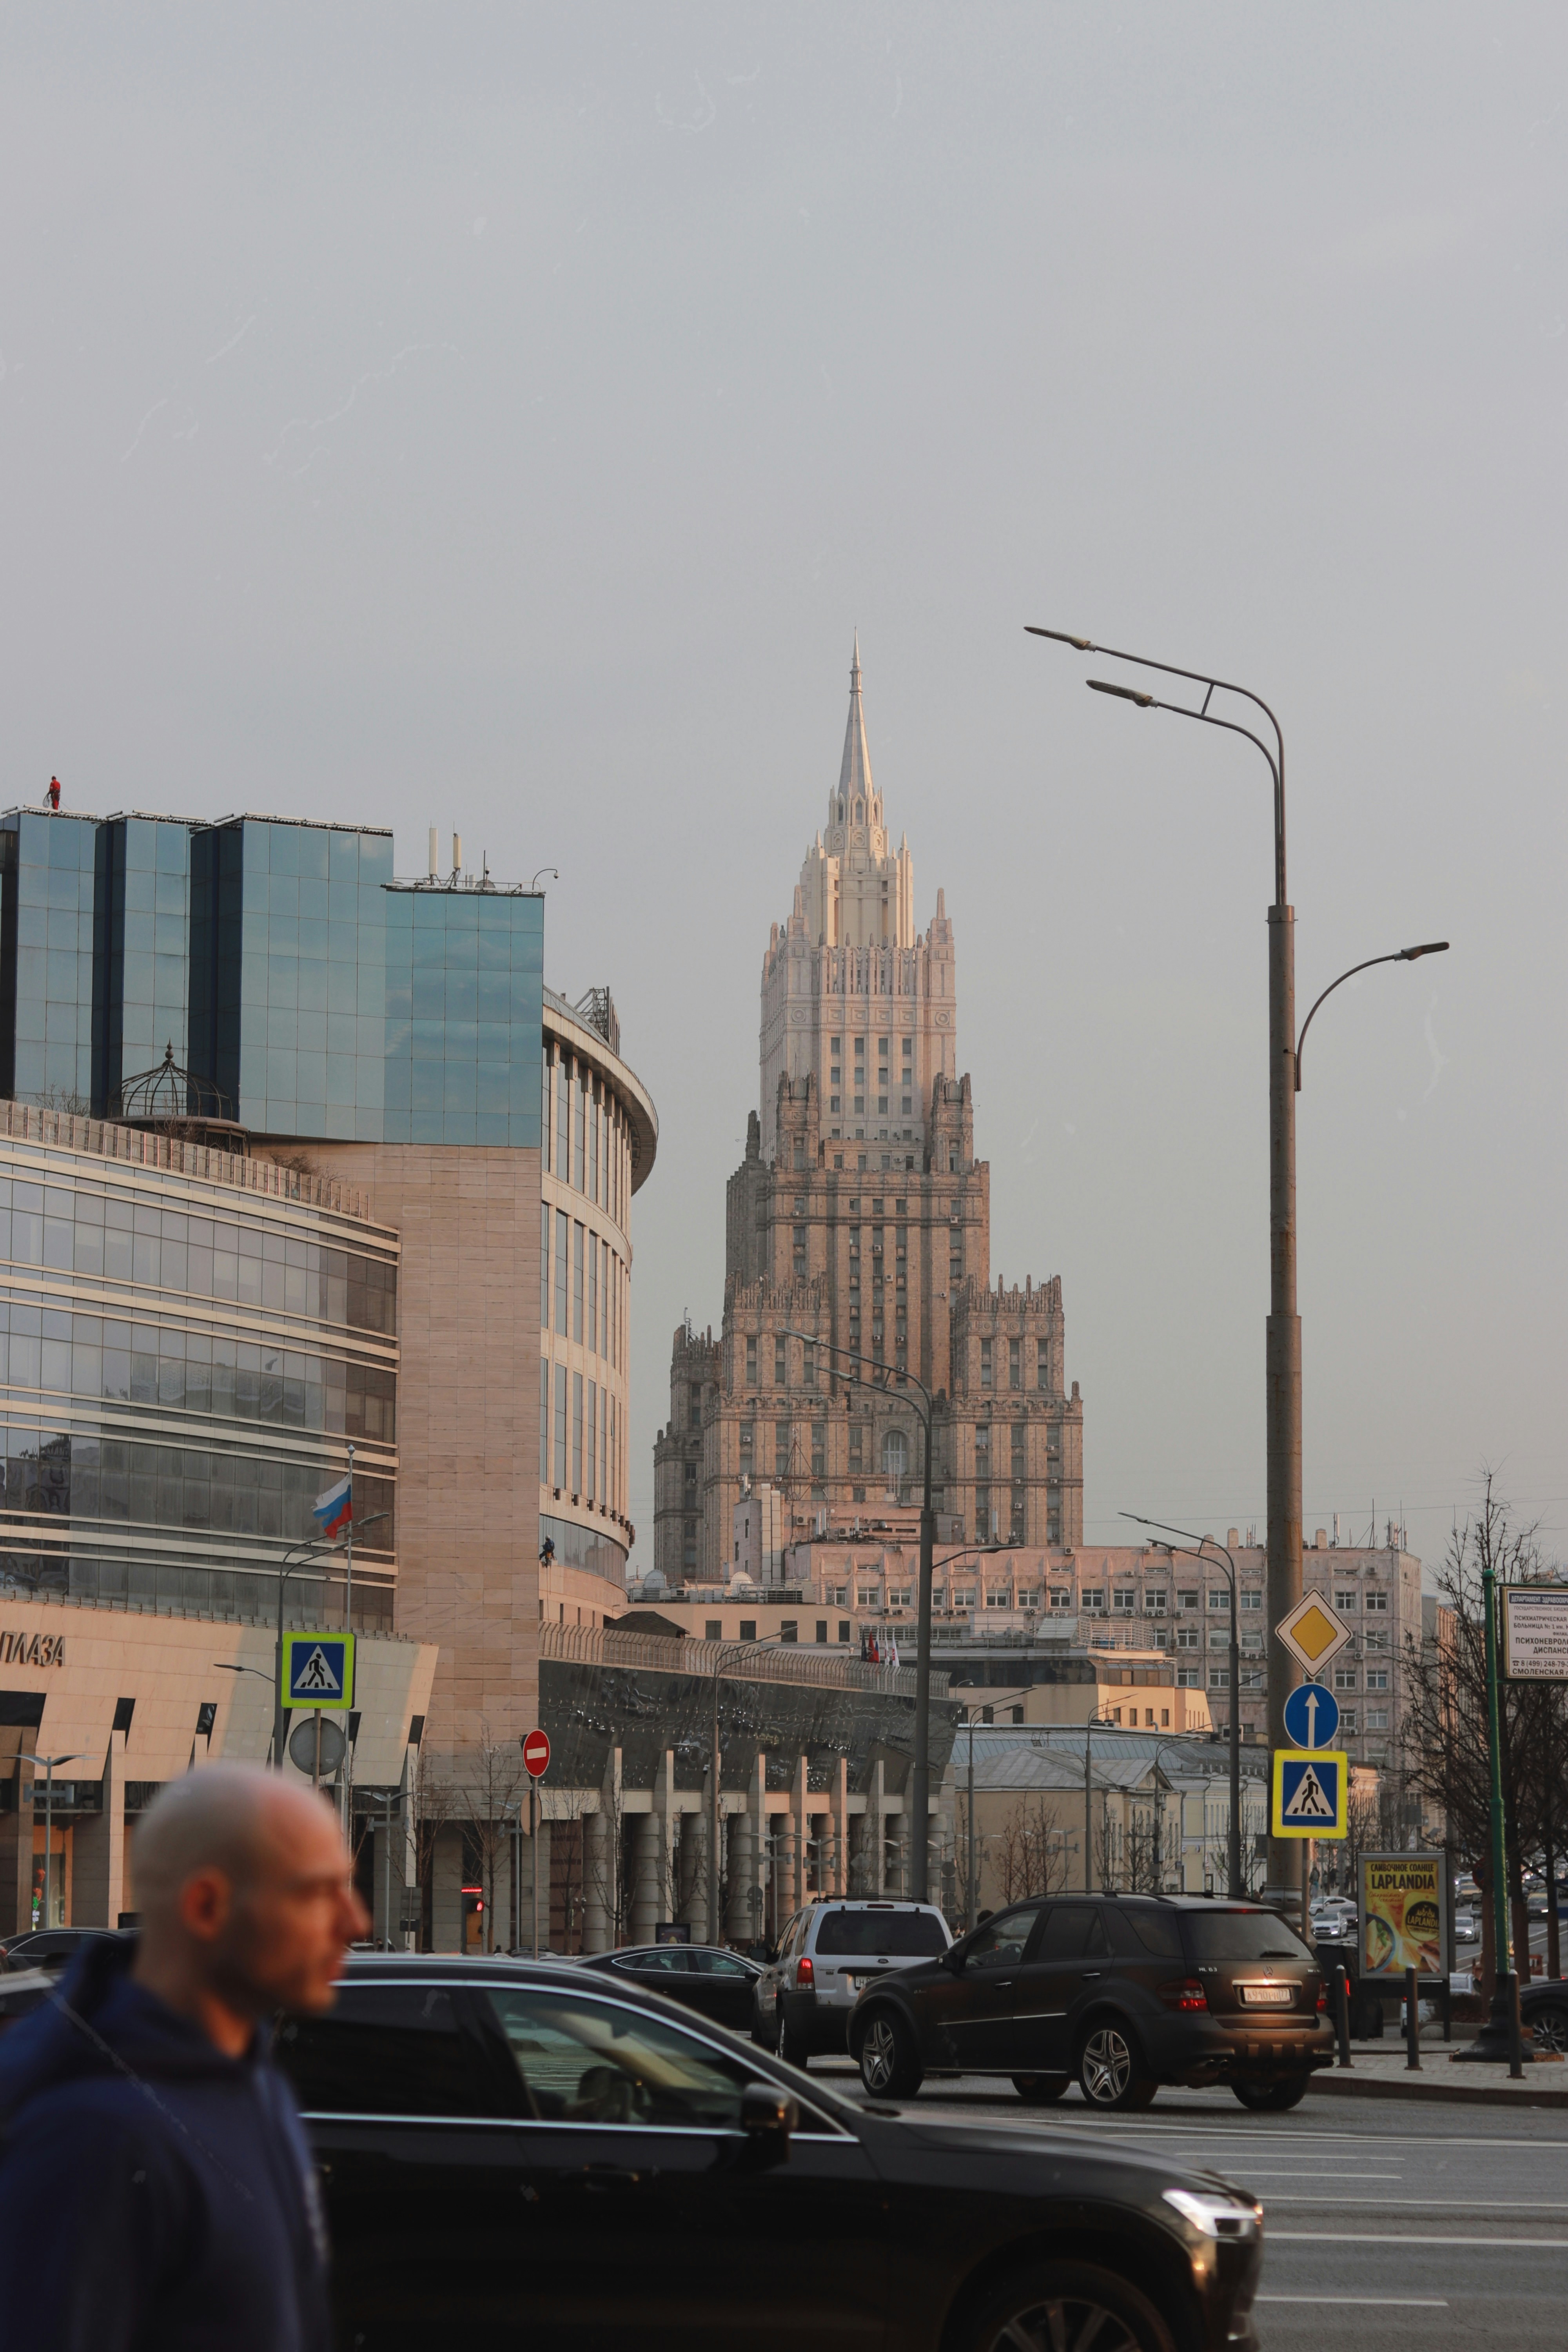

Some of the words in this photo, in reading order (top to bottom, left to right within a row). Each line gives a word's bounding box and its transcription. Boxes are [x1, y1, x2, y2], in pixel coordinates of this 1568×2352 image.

[0, 1631, 65, 1667] ПЛАЗА
[1410, 1864, 1434, 1872] СОЛНЦЕ
[1372, 1875, 1435, 1889] LAPLANDIA
